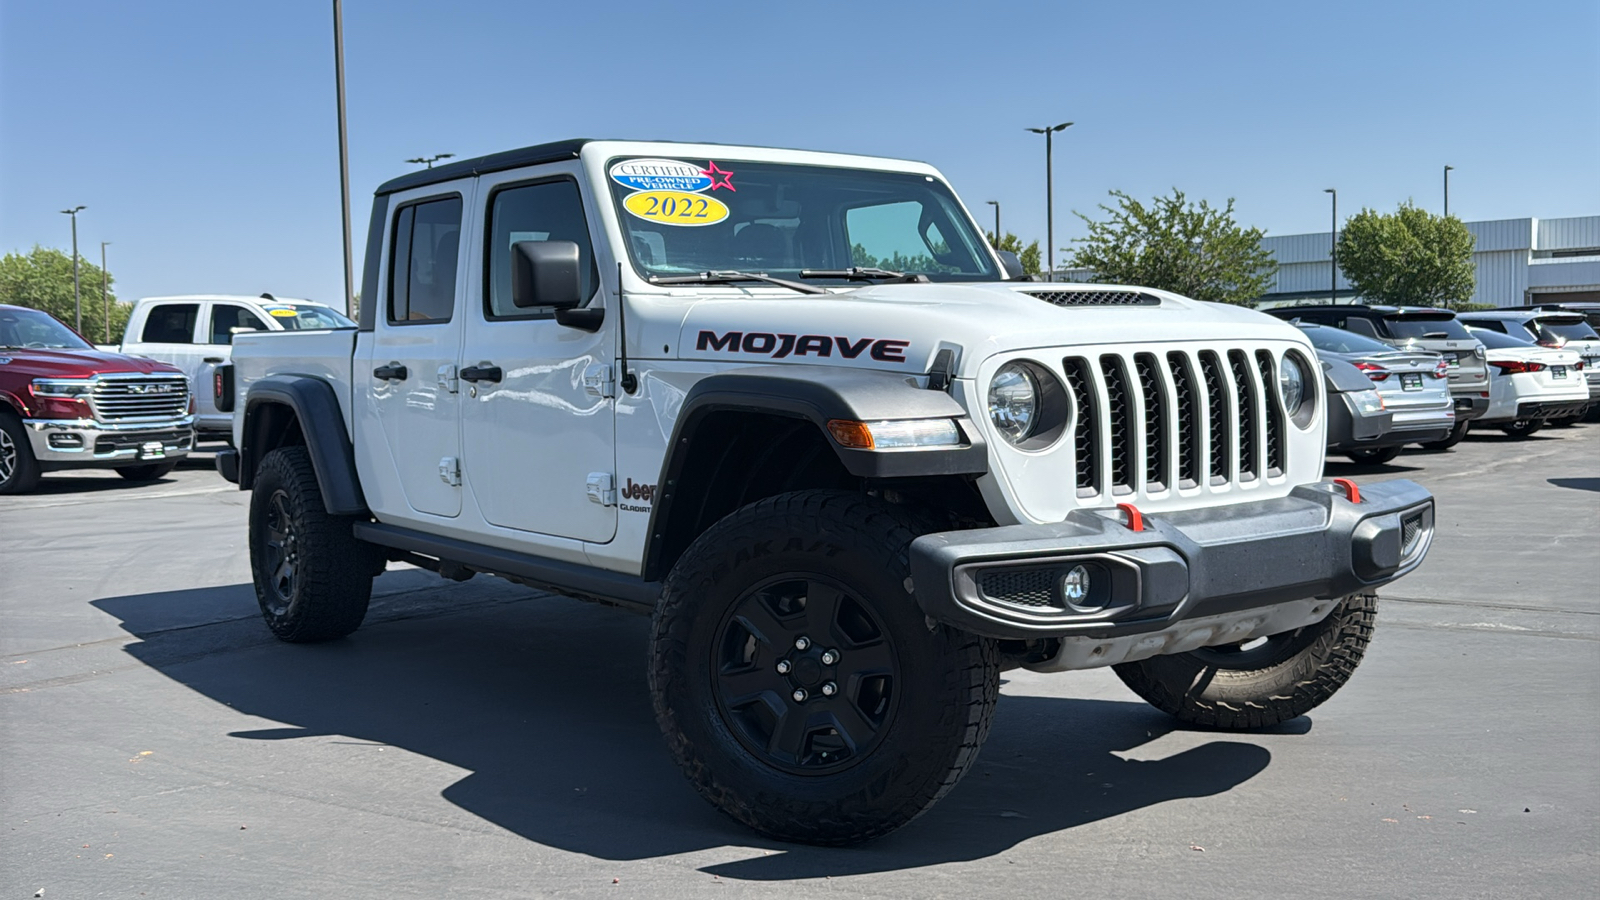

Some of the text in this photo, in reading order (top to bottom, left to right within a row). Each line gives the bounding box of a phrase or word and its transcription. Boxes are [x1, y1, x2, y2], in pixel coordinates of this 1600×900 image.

[620, 165, 700, 177] CERTIFIED
[629, 176, 701, 185] PRE-OWNED
[642, 182, 694, 190] VEHICLE
[644, 196, 709, 218] 2022
[696, 330, 910, 363] MOJAVE
[620, 503, 652, 513] GLADIAT
